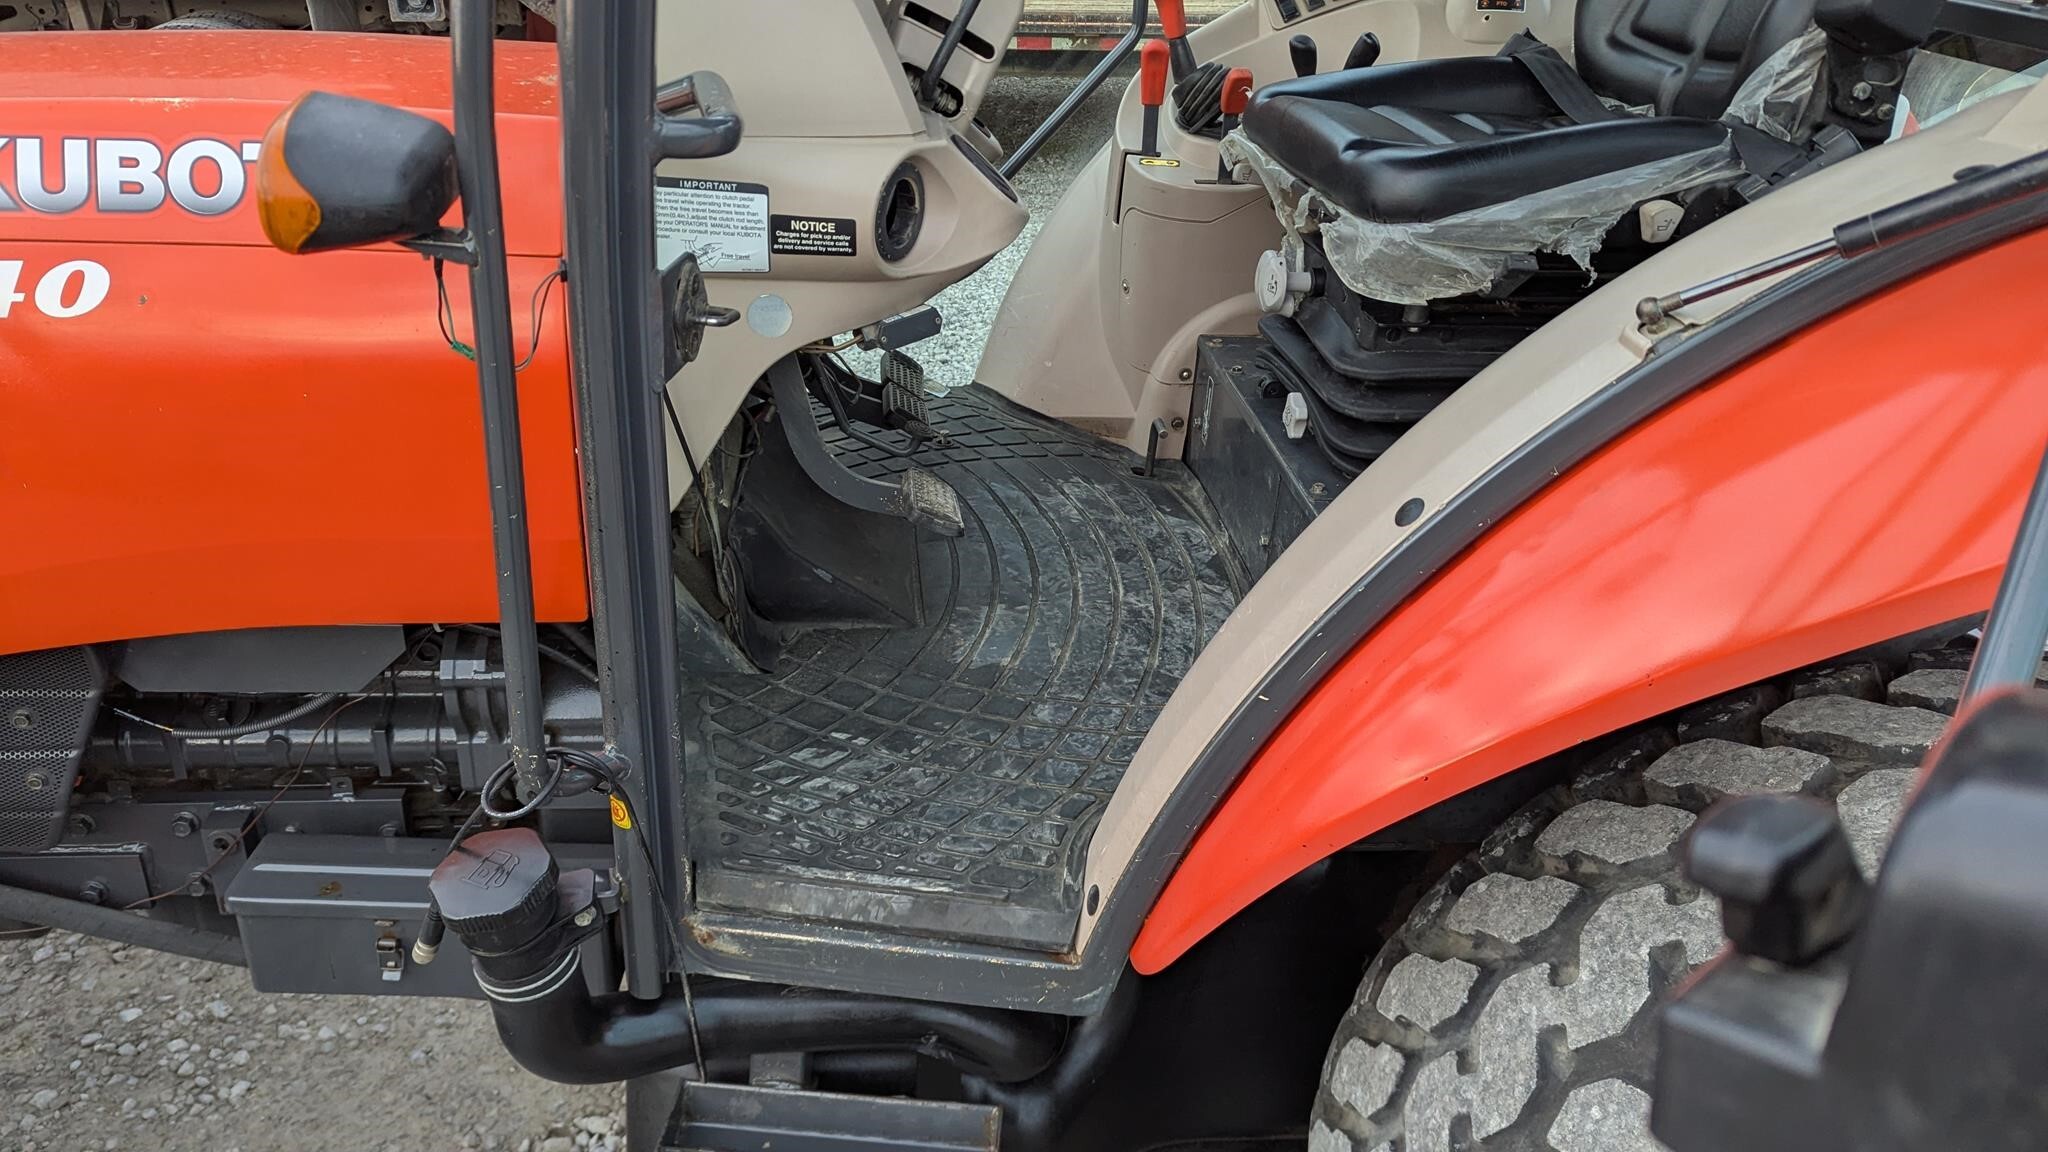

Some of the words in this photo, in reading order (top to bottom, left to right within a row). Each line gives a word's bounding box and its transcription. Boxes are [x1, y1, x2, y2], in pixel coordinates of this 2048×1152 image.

[0, 136, 261, 216] UBO
[680, 180, 737, 191] IMPORTANT
[791, 220, 836, 232] NOTICE
